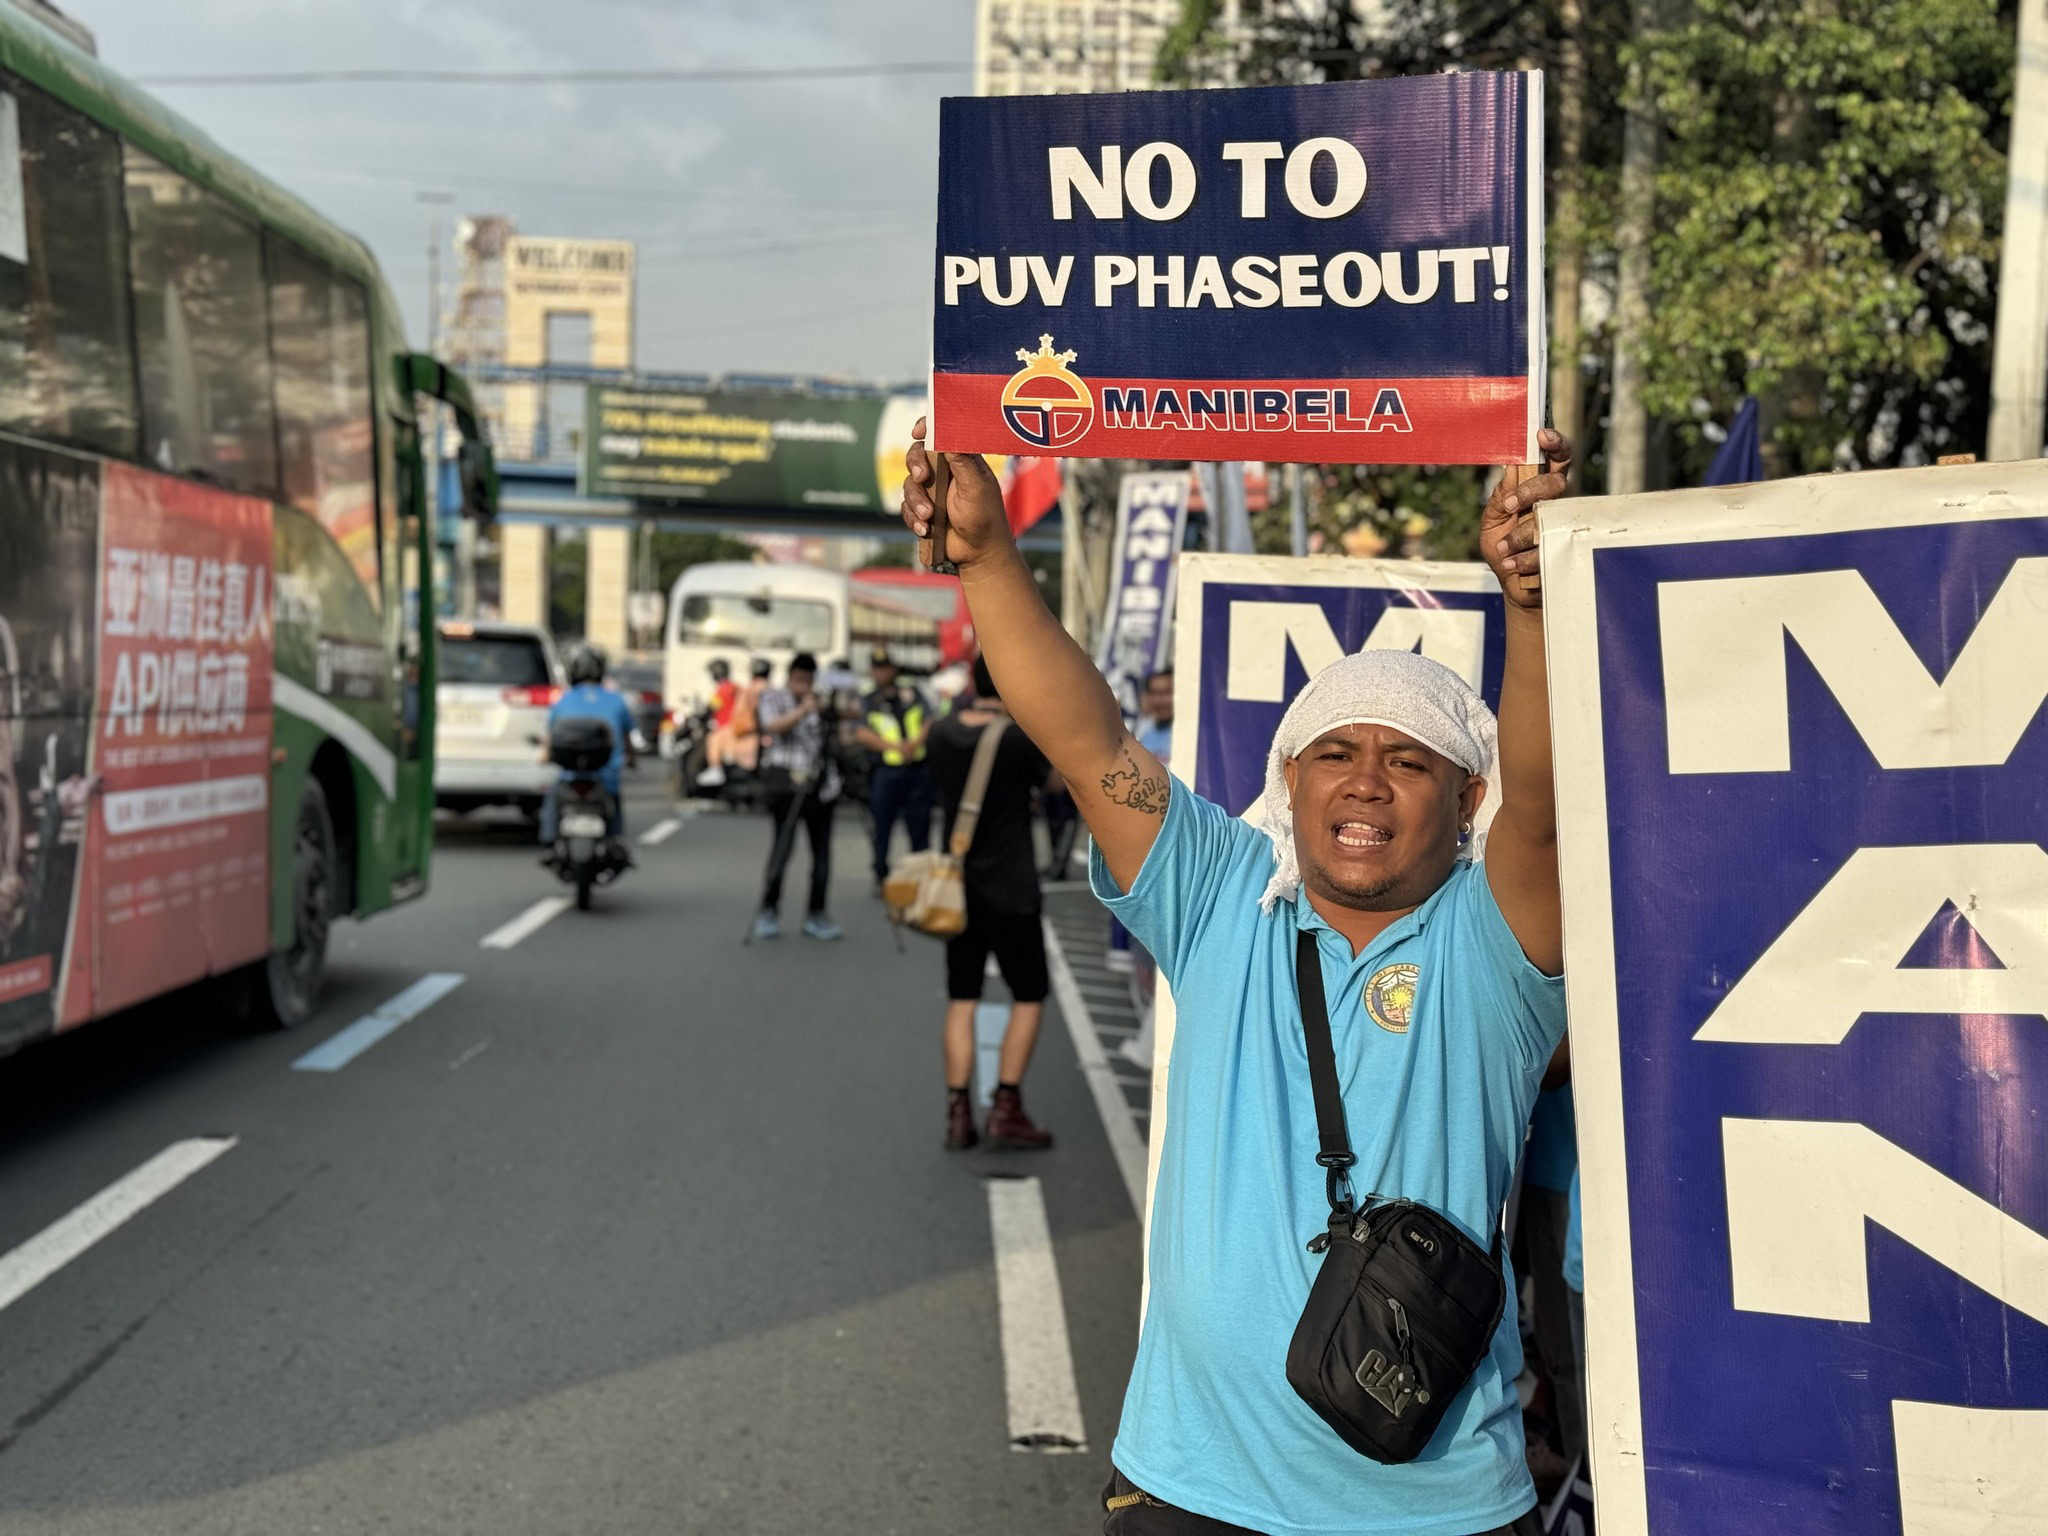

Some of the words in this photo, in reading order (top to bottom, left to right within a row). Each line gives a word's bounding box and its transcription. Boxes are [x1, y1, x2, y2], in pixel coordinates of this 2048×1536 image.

[1049, 142, 1196, 220] NO
[1223, 137, 1367, 218] TO
[945, 256, 1074, 306] PUV
[1095, 246, 1509, 308] PHASEOUT!
[1102, 386, 1414, 433] MANIBELA
